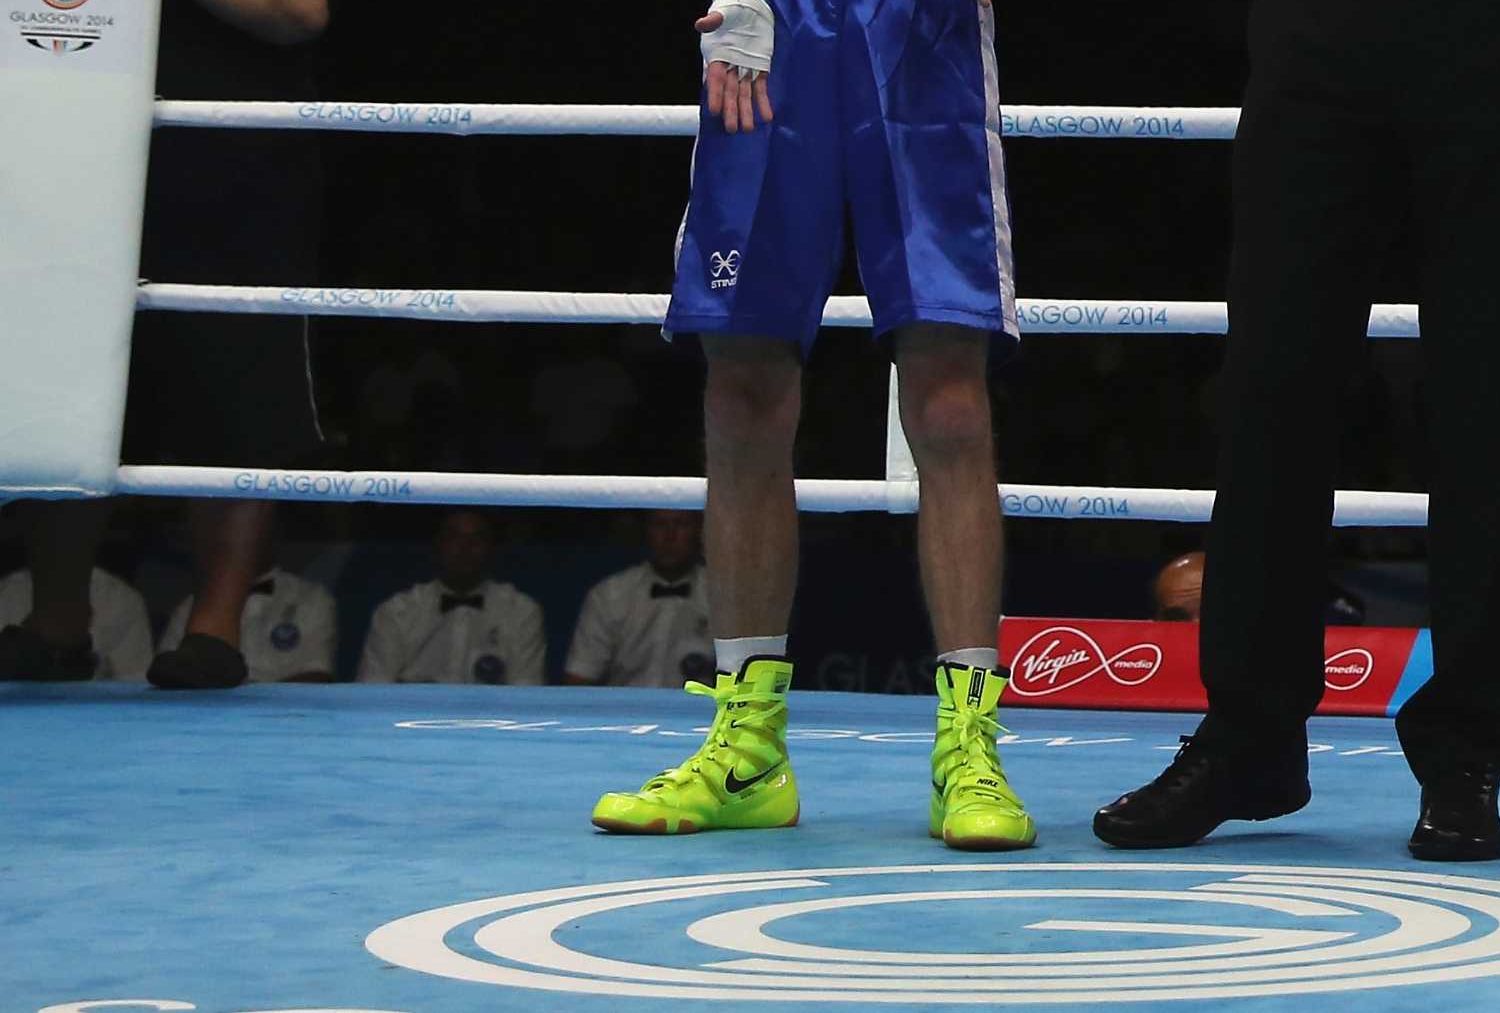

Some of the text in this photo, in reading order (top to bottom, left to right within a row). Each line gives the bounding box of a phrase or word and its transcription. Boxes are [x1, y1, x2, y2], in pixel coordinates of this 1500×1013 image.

[9, 11, 114, 27] GLASGOW 2014
[299, 103, 472, 125] GLASGOW 2014
[1133, 117, 1185, 136] 2014
[407, 290, 455, 308] 2014
[1118, 306, 1168, 325] 2014
[234, 472, 412, 497] GLASGOW 2014
[1078, 496, 1129, 515] 2014
[1023, 639, 1154, 685] Virgin media
[1325, 665, 1365, 674] media
